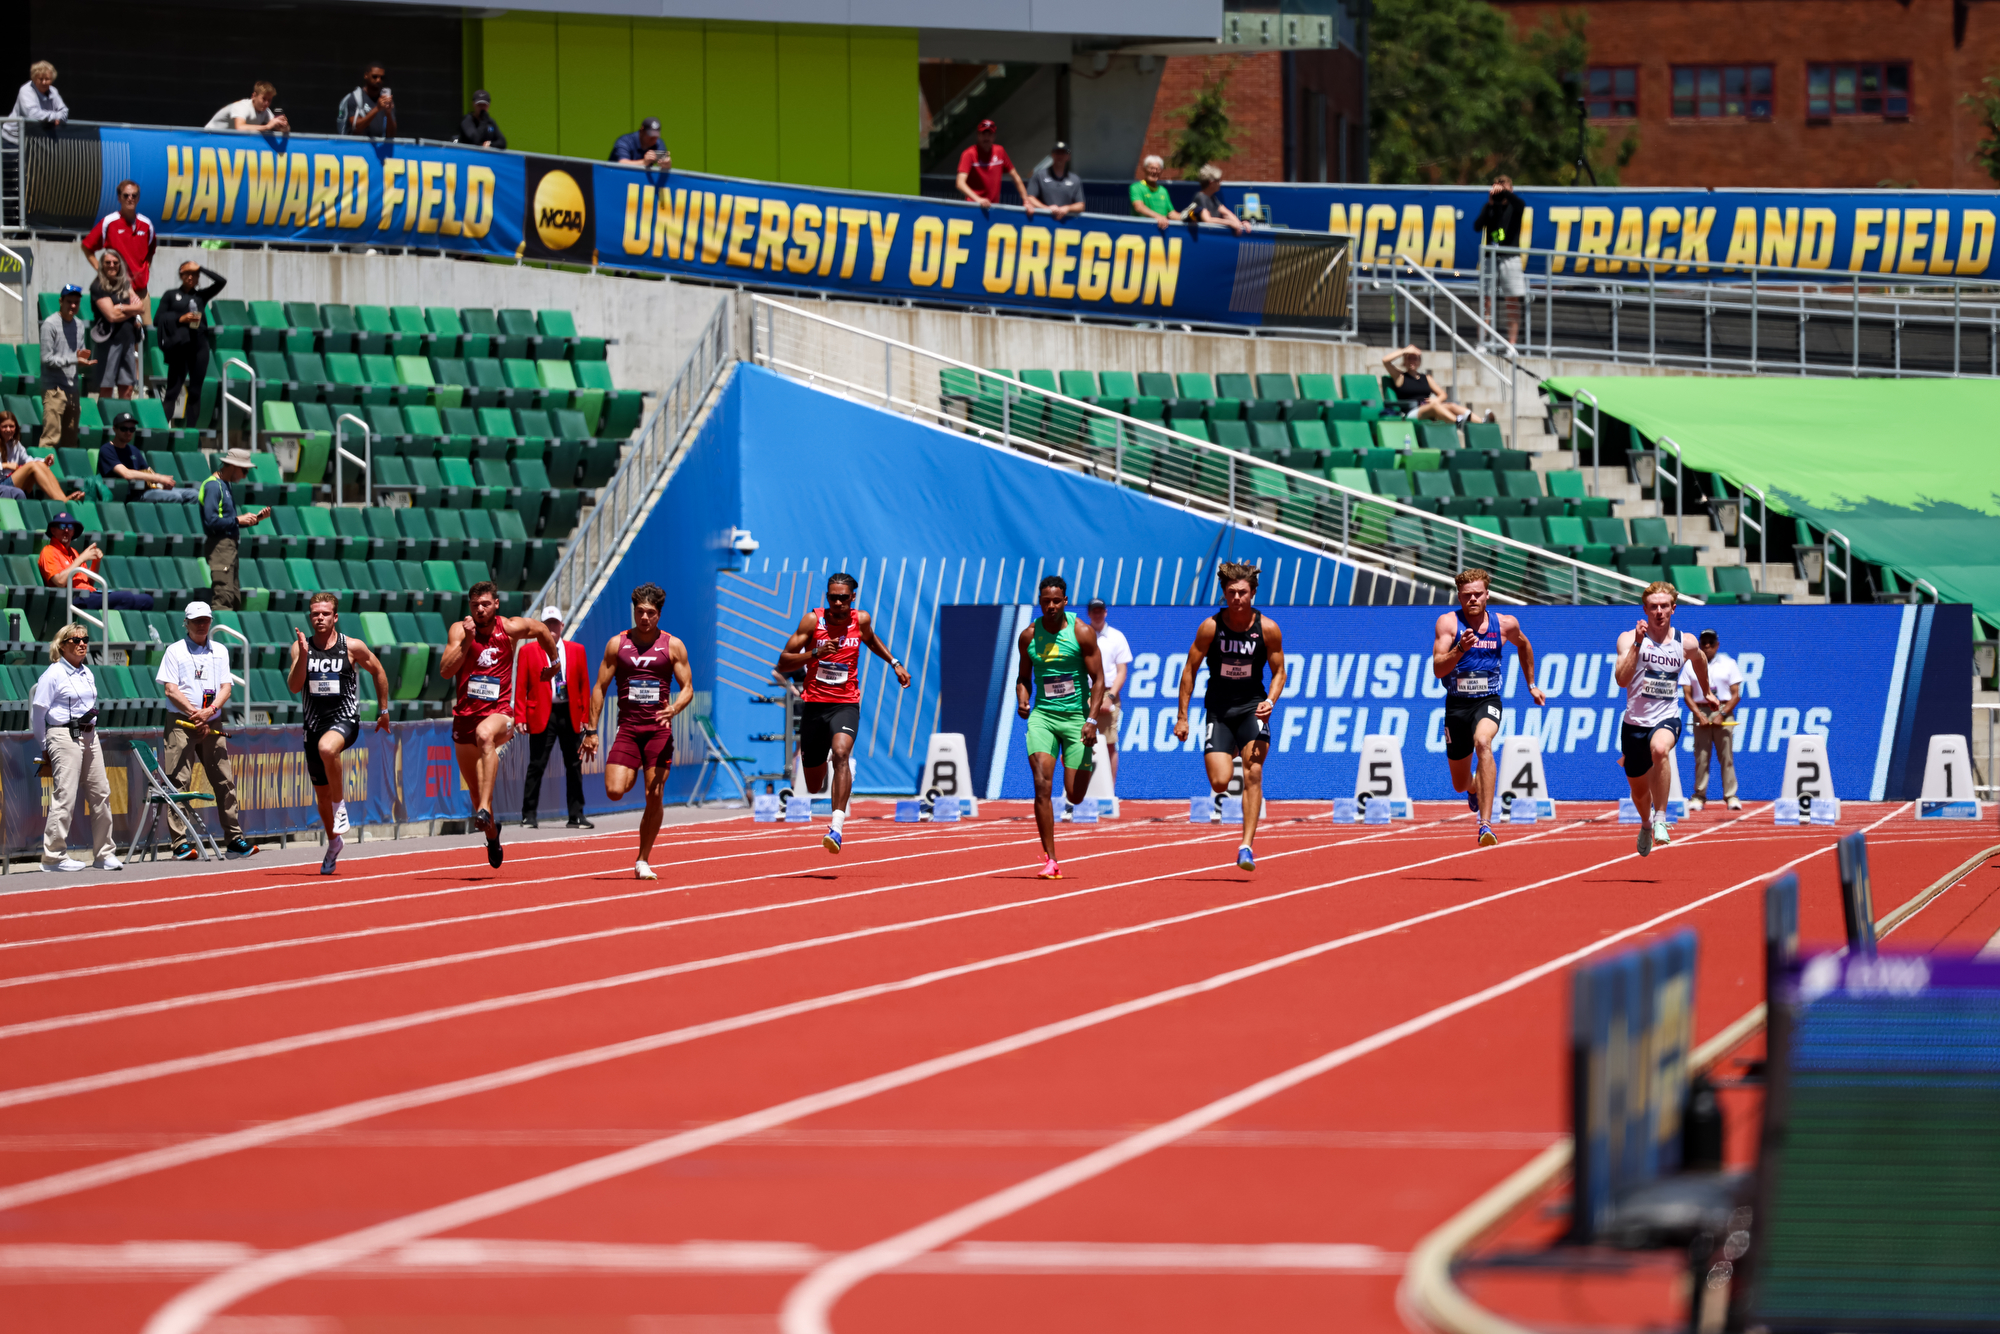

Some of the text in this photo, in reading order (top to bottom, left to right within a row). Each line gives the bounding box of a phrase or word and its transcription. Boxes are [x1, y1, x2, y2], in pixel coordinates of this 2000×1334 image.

[161, 145, 496, 238] HAYWARD FIELD
[539, 207, 582, 233] NCAA
[622, 183, 1183, 307] UNIVERSITY OF OREGON
[1549, 206, 1717, 273] TRACK
[1723, 206, 1837, 274] AND
[1848, 207, 1997, 275] FIELD
[112, 651, 123, 660] 127
[816, 636, 859, 648] BECATS
[1220, 639, 1256, 655] UIW
[1471, 641, 1497, 649] LINGTON
[308, 658, 344, 673] HCU
[630, 656, 657, 667] VT
[1642, 652, 1681, 667] UCONN
[1128, 653, 1766, 698] 202 DIVISIO I OUTR
[1645, 686, 1673, 695] O'CONNOR
[254, 713, 265, 722] 127
[1116, 706, 1207, 752] ACK
[1277, 706, 1411, 753] FIELD
[932, 761, 957, 795] 8
[1369, 762, 1392, 796] 5
[1511, 762, 1538, 797] 4
[1797, 762, 1820, 797] 2
[1943, 762, 1952, 798] 1
